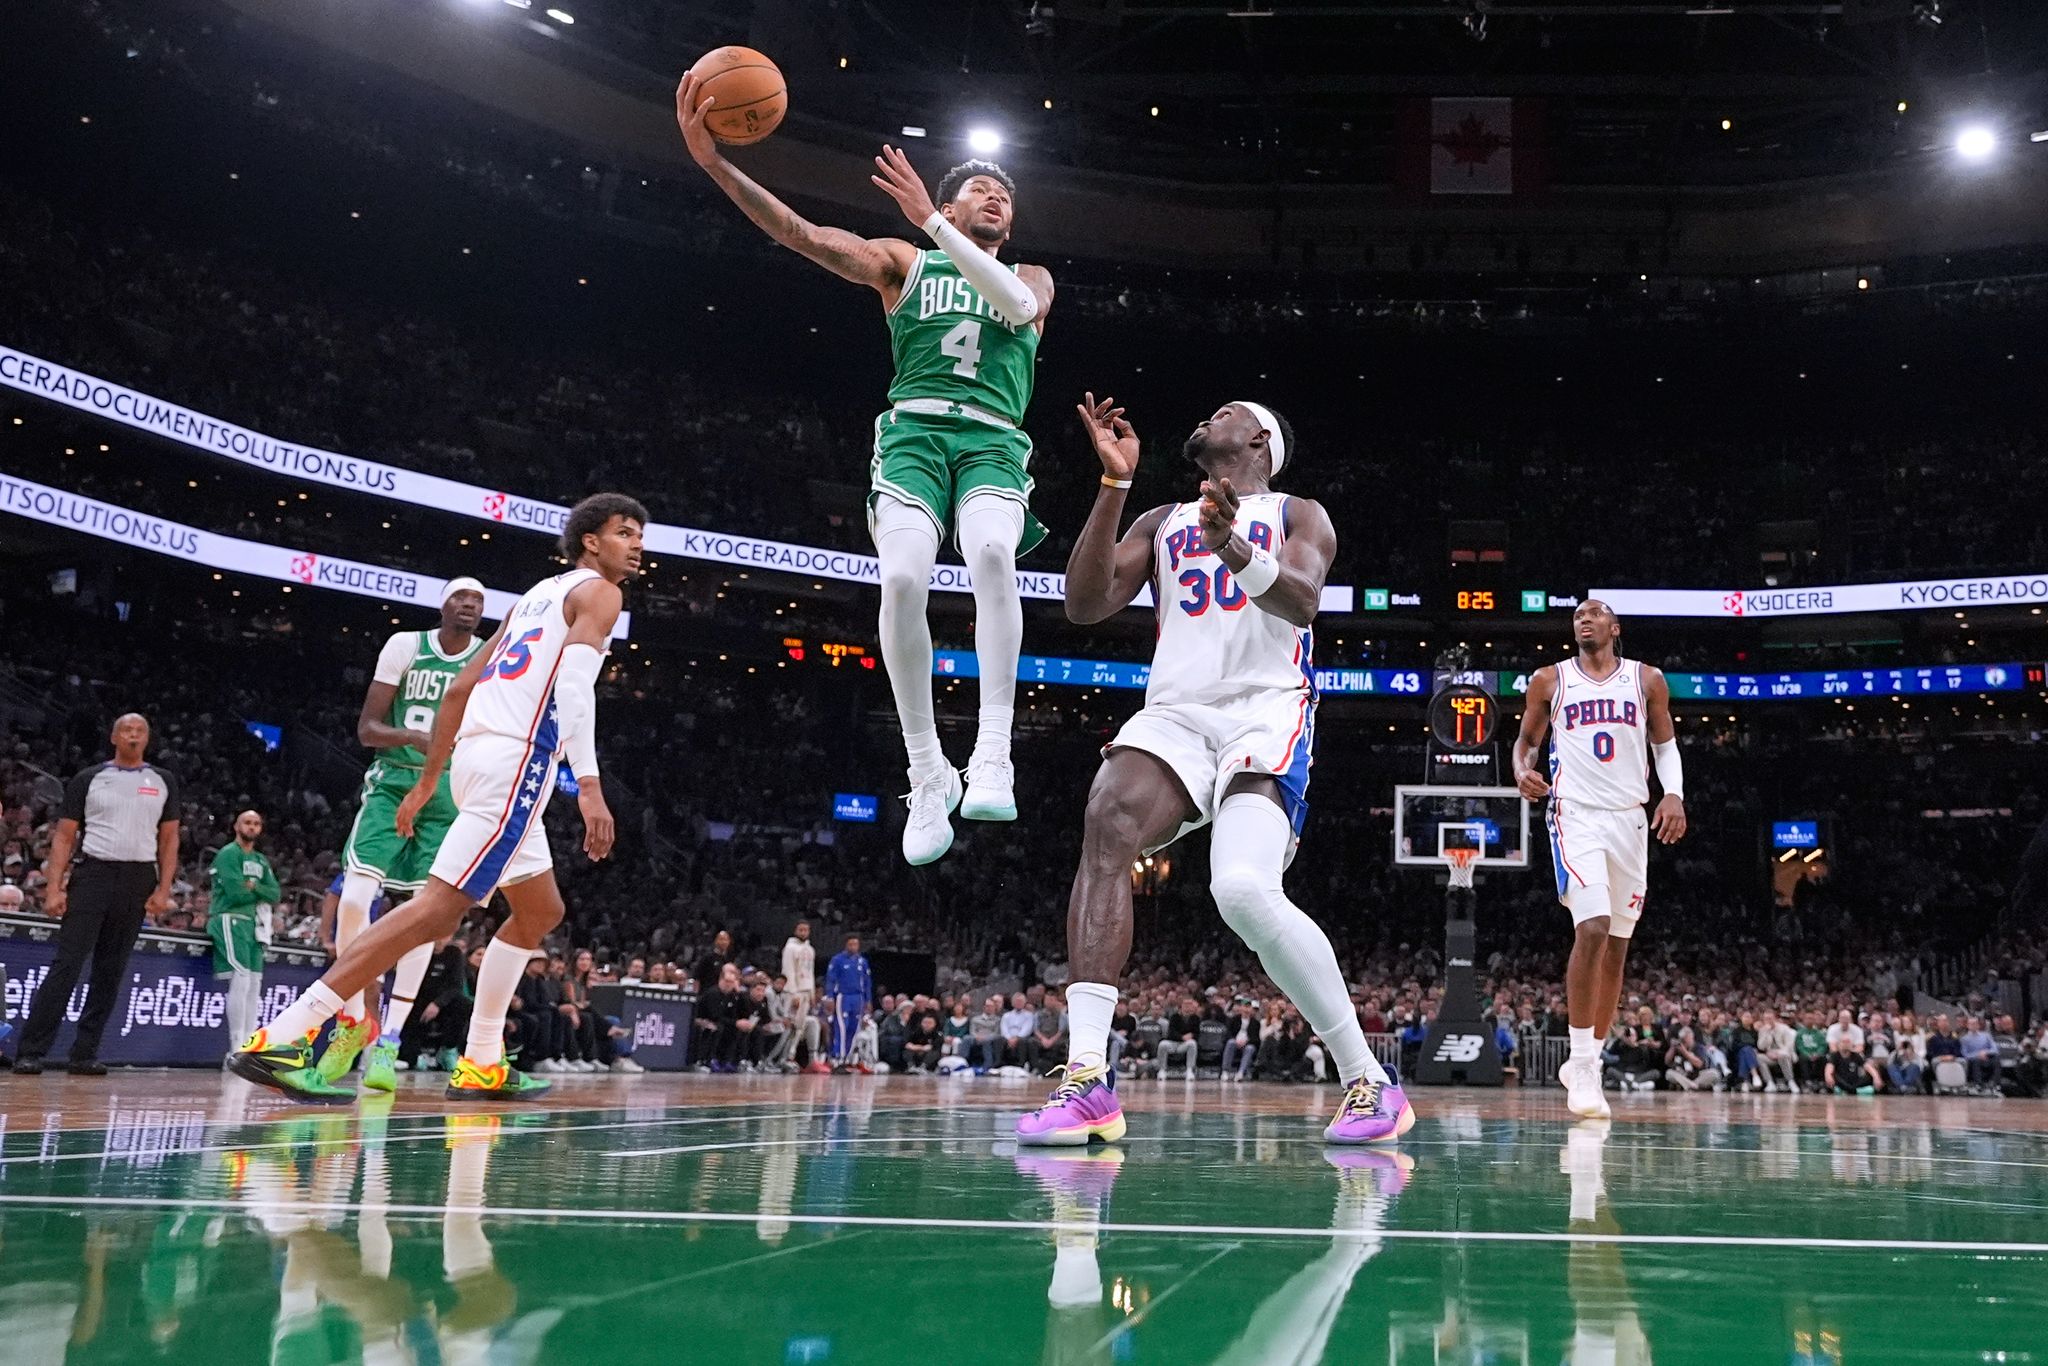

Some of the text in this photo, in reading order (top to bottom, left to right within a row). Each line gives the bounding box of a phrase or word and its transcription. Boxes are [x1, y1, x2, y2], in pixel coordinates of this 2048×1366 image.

[940, 320, 982, 379] 4
[0, 355, 396, 491] CERADOCUMENTSOLUTIONS.US
[0, 478, 198, 554] TSOLUTIONS.US
[508, 500, 570, 530] KYOCE
[1178, 563, 1248, 617] 30
[1392, 594, 1421, 606] Bank
[1457, 591, 1494, 610] 8:25
[1549, 596, 1578, 608] Bank
[1901, 580, 2048, 604] KYOCERADO
[404, 669, 456, 701] BOST
[1036, 668, 1045, 679] 2
[1063, 670, 1070, 680] 7
[1092, 672, 1117, 683] 5/14
[1390, 673, 1420, 692] 43
[1512, 674, 1532, 693] 4
[1694, 685, 1702, 695] 4
[1718, 685, 1726, 696] 5
[1451, 697, 1485, 715] 4:27
[1564, 699, 1637, 730] PHILA
[1456, 714, 1483, 743] 11
[1593, 731, 1615, 763] 0
[121, 973, 225, 1036] jetBlue
